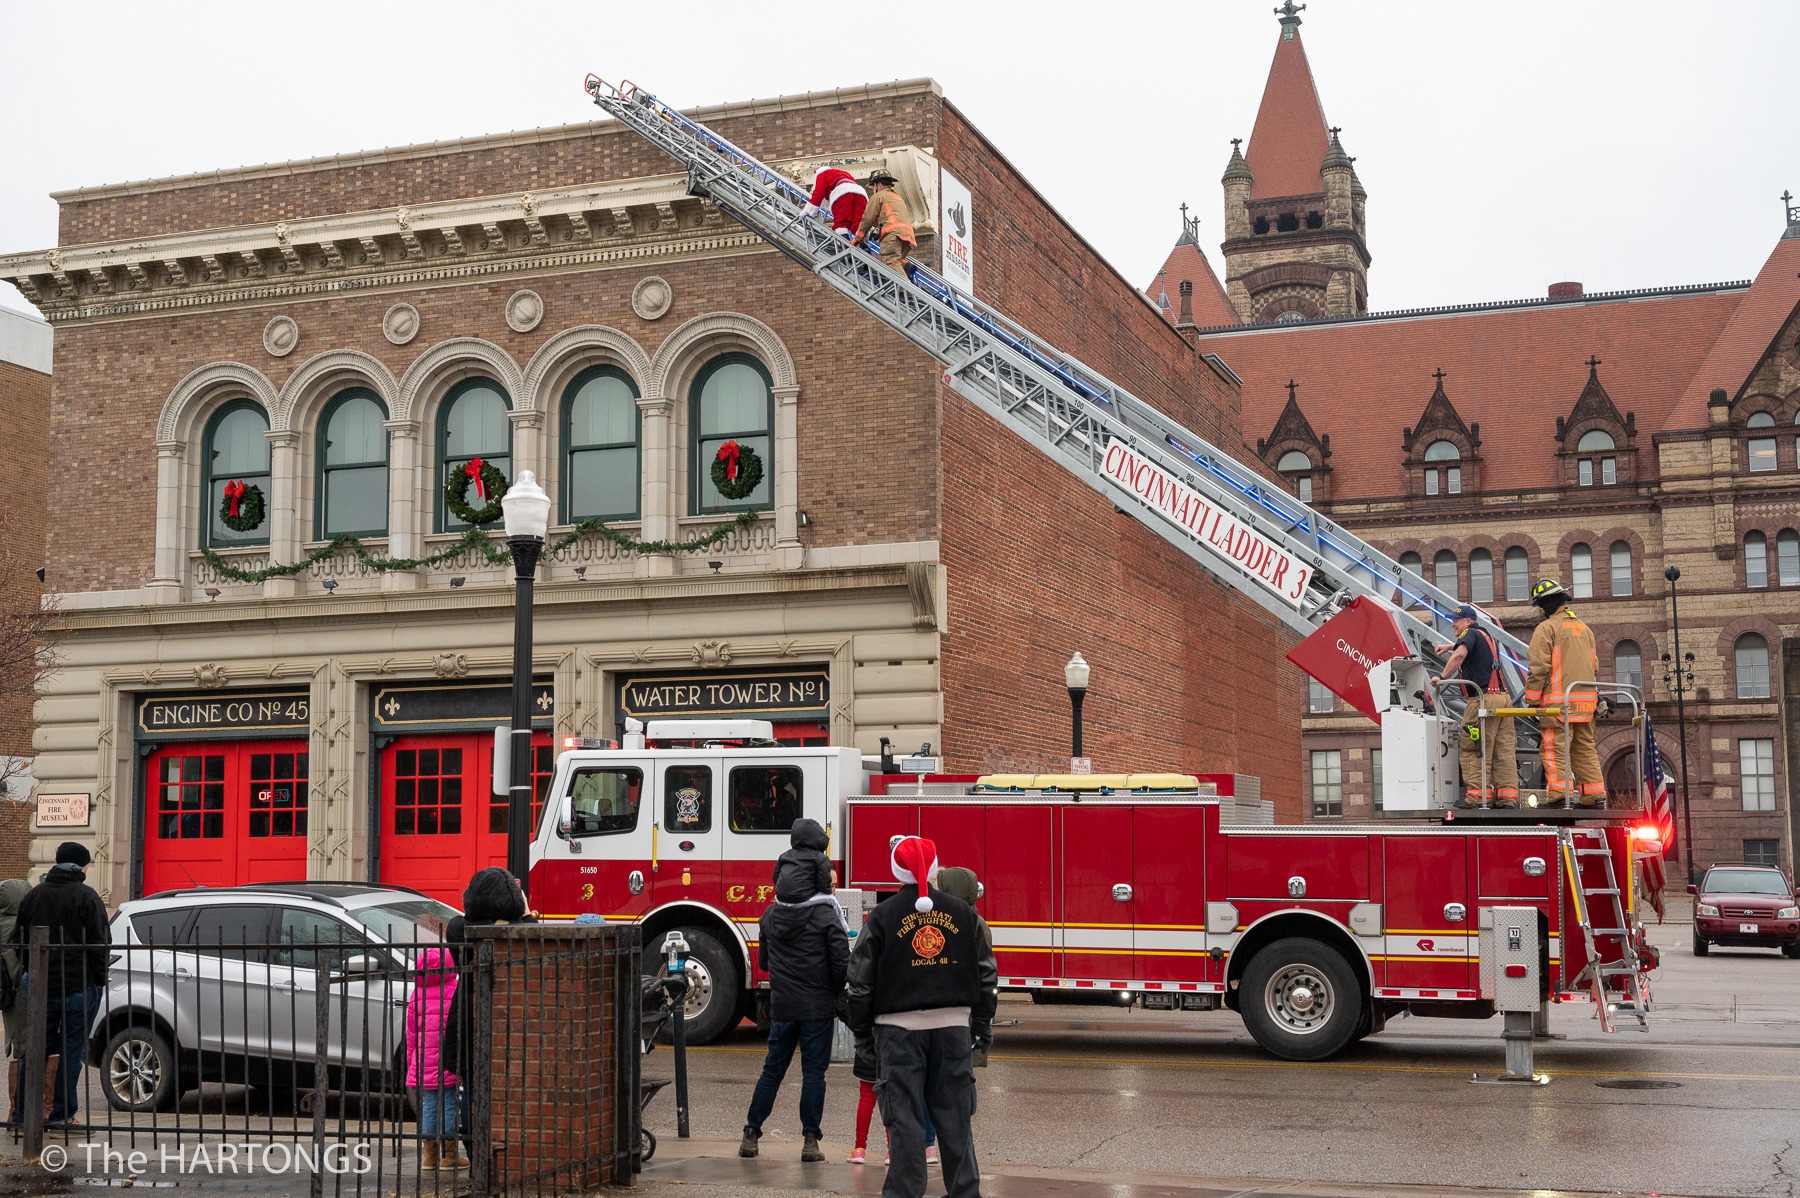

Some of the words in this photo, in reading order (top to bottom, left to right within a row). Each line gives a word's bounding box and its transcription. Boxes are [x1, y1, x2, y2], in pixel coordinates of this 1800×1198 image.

[948, 234, 967, 263] FIRE
[1073, 399, 1084, 410] 100
[1128, 435, 1137, 445] 90
[1186, 473, 1195, 483] 80
[1104, 445, 1214, 537] CINCINNATI
[1208, 512, 1290, 591] LADDER
[1289, 569, 1307, 600] 3
[1247, 512, 1256, 524] 70
[1325, 522, 1334, 533] 70
[1313, 556, 1323, 568] 60
[1392, 565, 1402, 576] 60
[631, 685, 701, 707] WATER
[706, 682, 781, 705] TOWER
[818, 681, 825, 701] 1
[152, 704, 222, 725] ENGINE
[226, 702, 253, 722] CO
[285, 701, 308, 720] 45
[580, 866, 598, 874] 51650
[581, 883, 594, 900] 3
[901, 910, 953, 925] CINCINNATI
[896, 921, 916, 938] FIRE
[918, 917, 959, 934] FIGHTERS
[911, 958, 937, 966] LOCAL
[939, 957, 948, 965] 48
